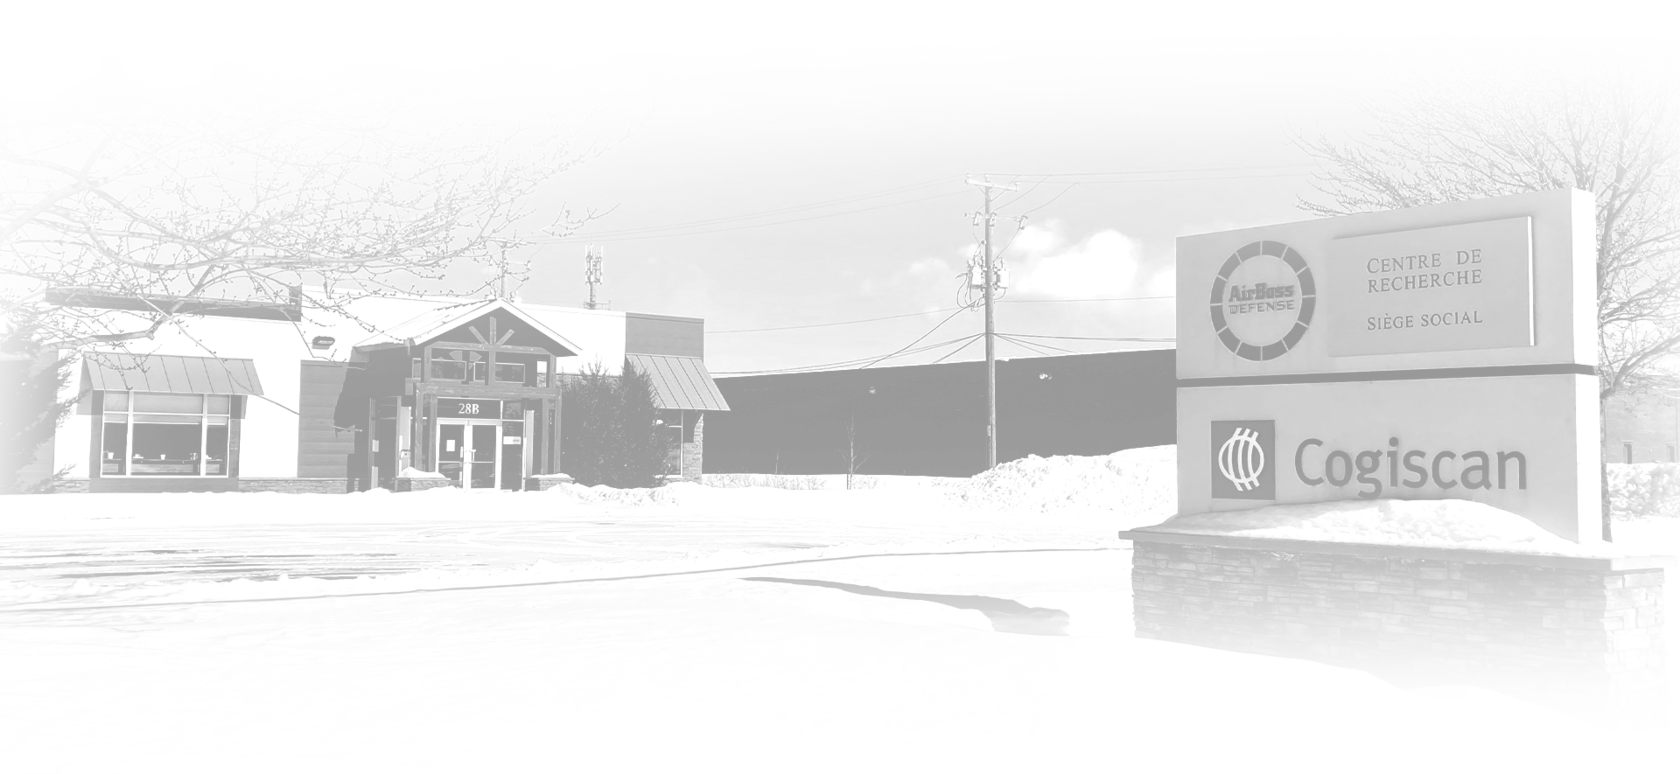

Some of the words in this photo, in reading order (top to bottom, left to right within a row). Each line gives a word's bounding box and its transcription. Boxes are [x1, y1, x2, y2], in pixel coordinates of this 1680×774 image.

[1366, 253, 1442, 274] CENTRE
[1456, 248, 1482, 265] DE
[1367, 269, 1483, 293] RECHERCHE
[1228, 282, 1295, 302] AirBoss
[1228, 300, 1295, 315] DEFENSE
[1367, 312, 1414, 331] SIÈGE
[1420, 310, 1483, 327] SOCIAL
[458, 403, 480, 414] 28B
[1294, 436, 1527, 499] Cogiscan
